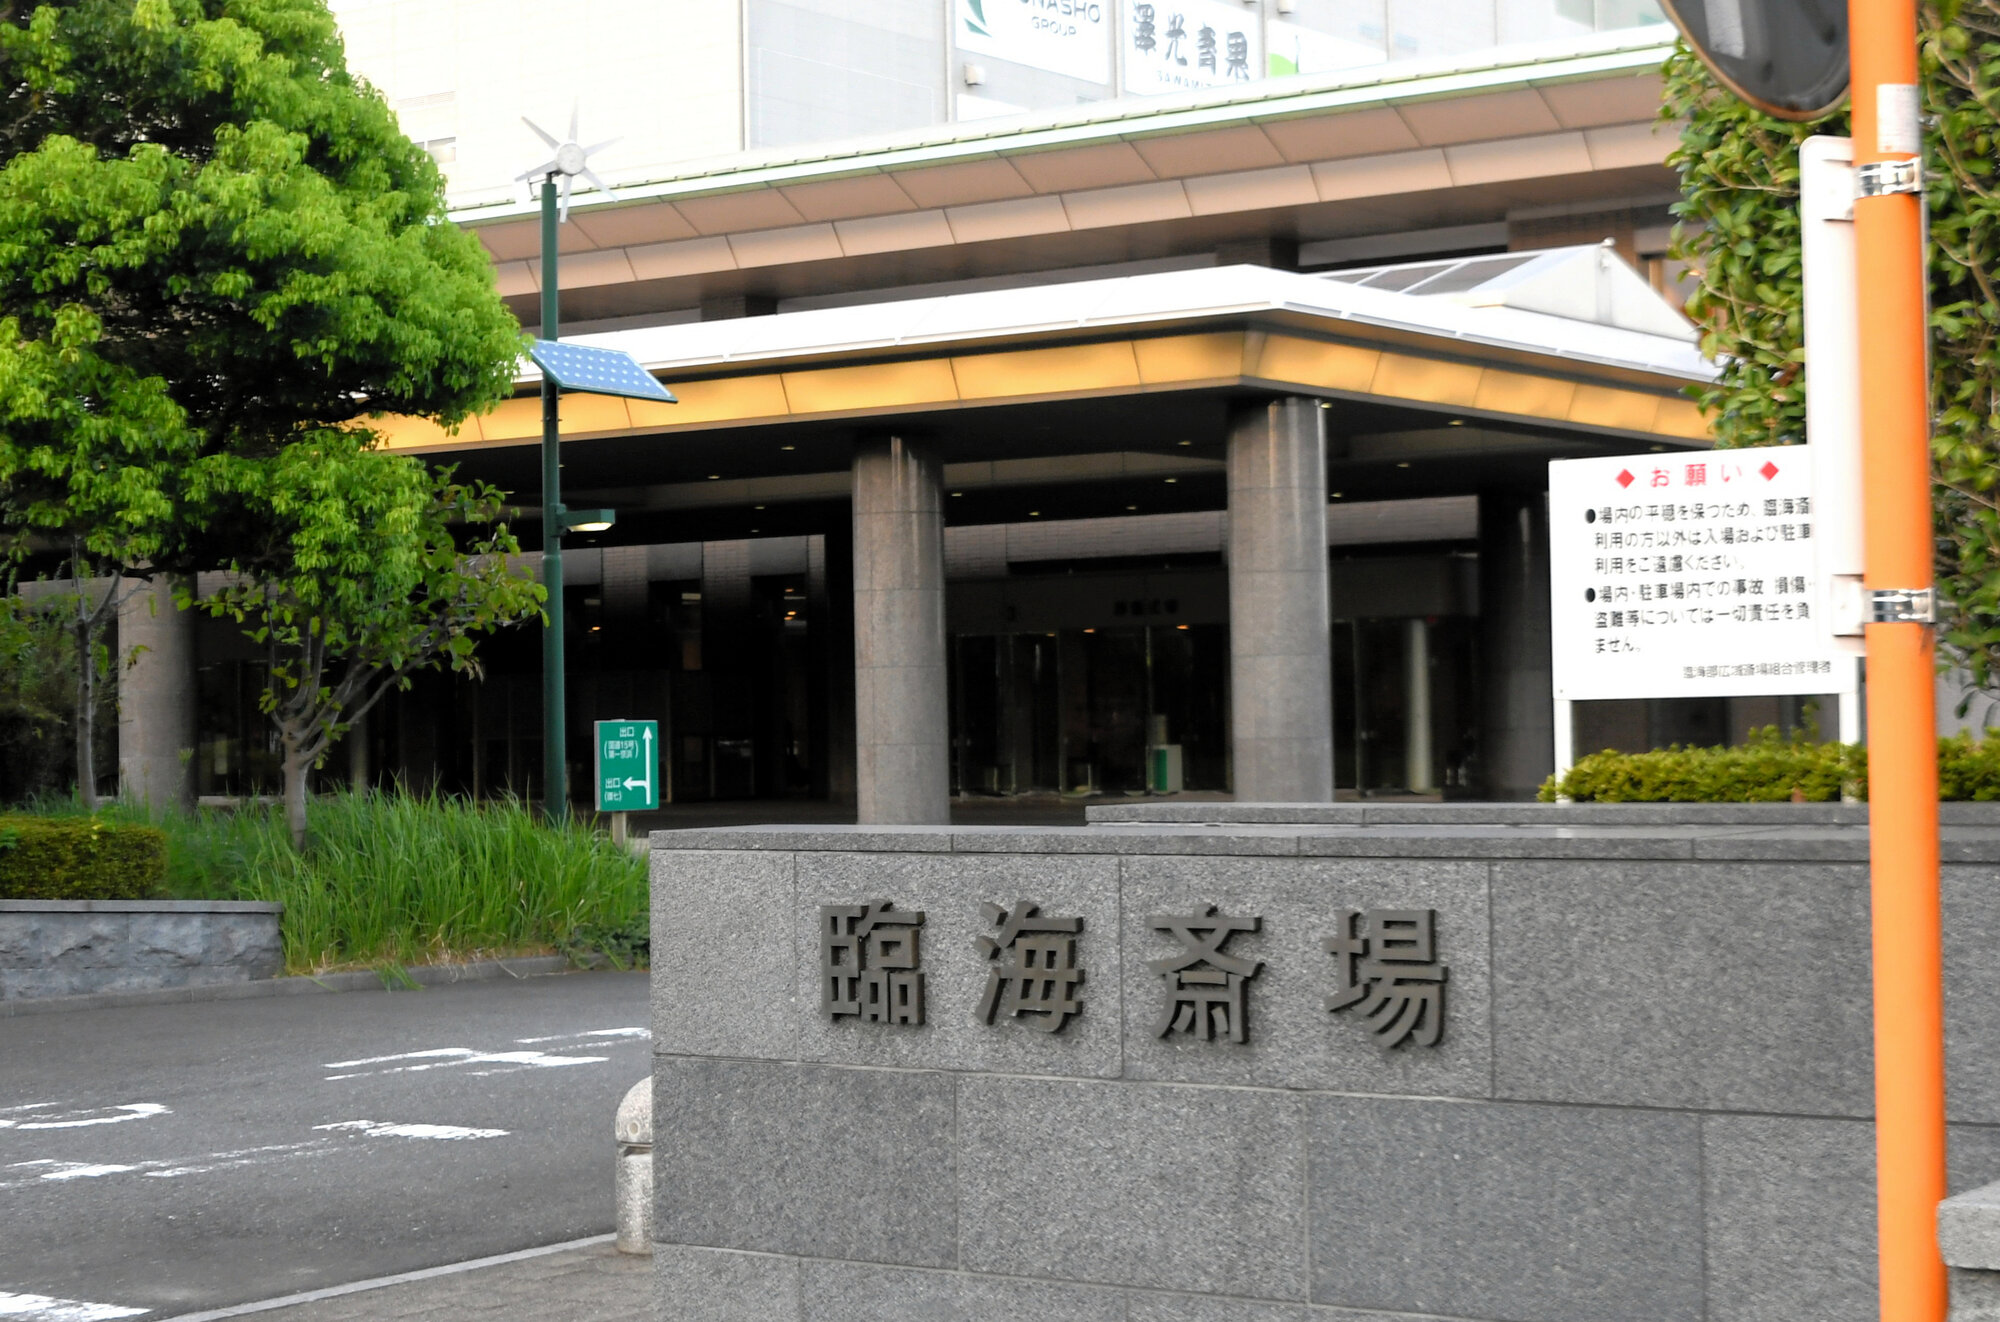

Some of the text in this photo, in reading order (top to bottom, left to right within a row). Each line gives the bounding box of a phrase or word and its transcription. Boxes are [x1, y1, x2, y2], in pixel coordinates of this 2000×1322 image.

[1019, 0, 1101, 23] NASHO
[1031, 16, 1077, 36] GROUP
[1649, 463, 1743, 488] お願い
[1595, 636, 1641, 654] ません。
[619, 726, 635, 737] 出口
[605, 777, 621, 789] 出口
[820, 900, 1449, 1048] 臨海斎場
